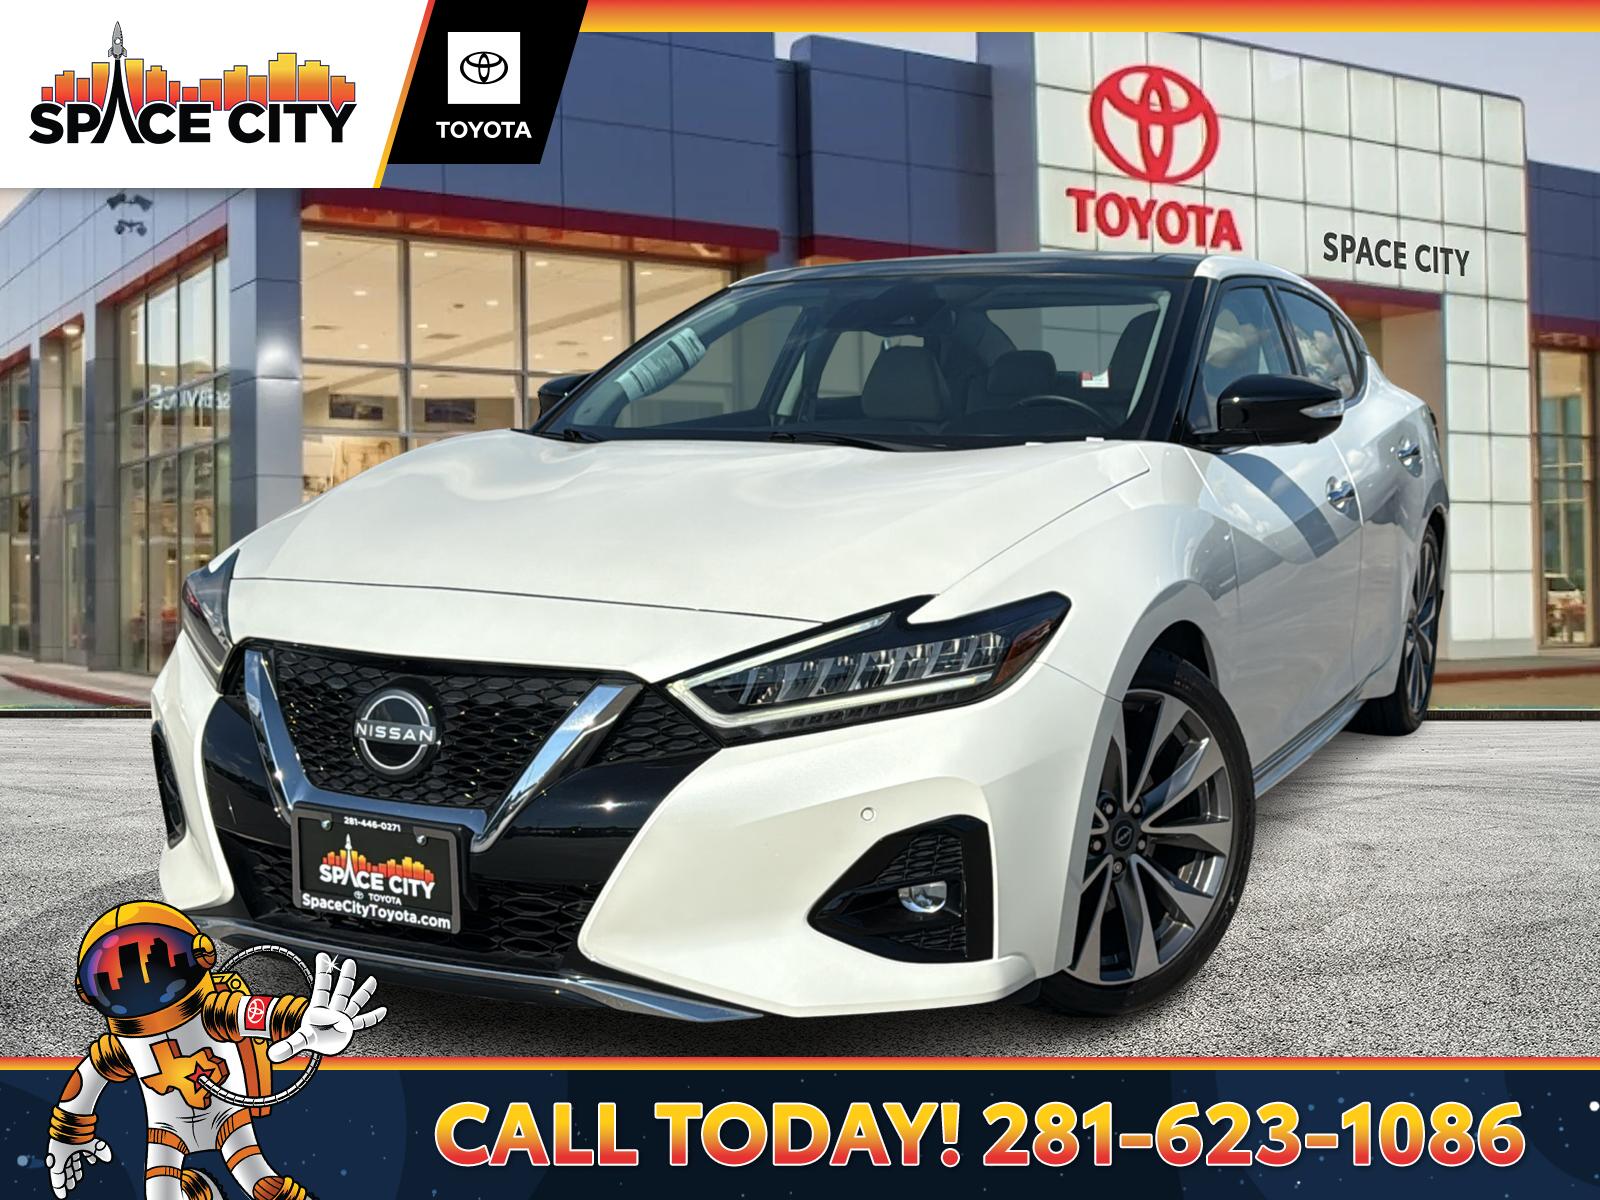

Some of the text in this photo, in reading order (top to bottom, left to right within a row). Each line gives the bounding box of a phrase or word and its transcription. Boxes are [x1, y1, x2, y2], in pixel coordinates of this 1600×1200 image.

[1066, 188, 1242, 251] TOYOTA
[1322, 231, 1470, 278] SPACE CITY
[355, 722, 433, 742] NISSAN
[344, 816, 401, 832] 281-446-0271
[318, 858, 435, 900] SPACE CITY
[302, 892, 451, 930] SpaceCityToyota.com
[368, 892, 402, 906] TOYOTA
